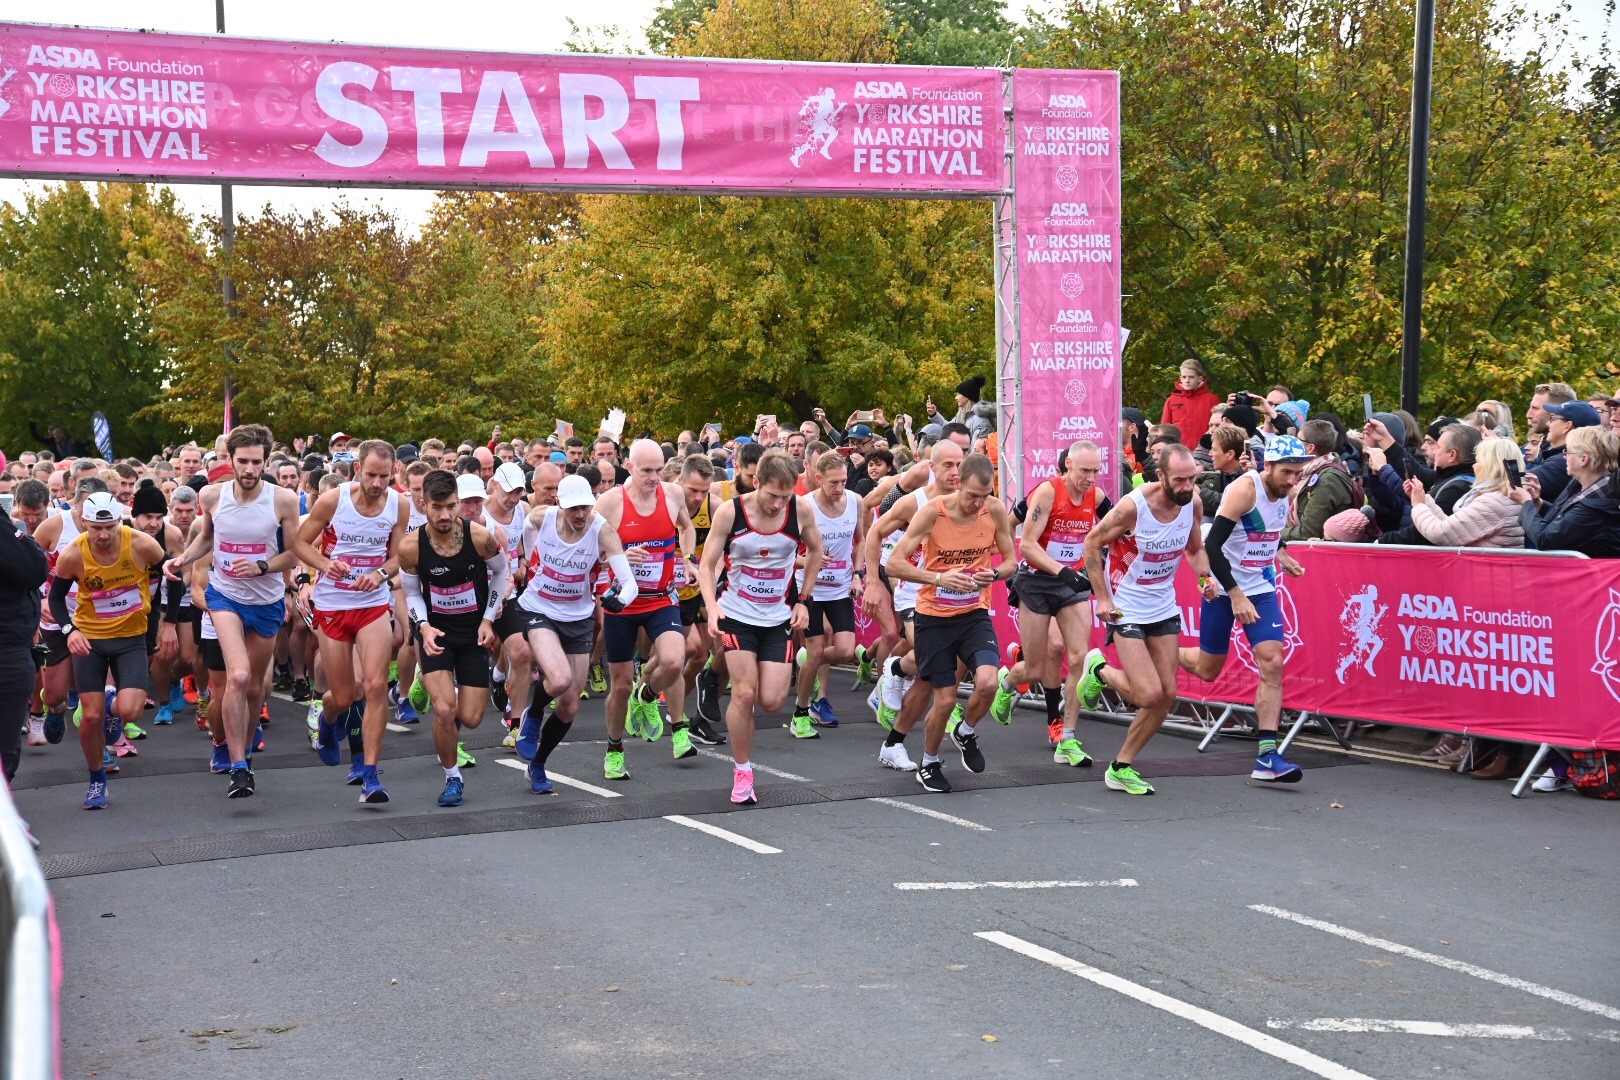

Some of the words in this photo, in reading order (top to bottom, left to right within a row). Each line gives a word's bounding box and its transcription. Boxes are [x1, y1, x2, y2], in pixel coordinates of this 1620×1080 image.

[27, 45, 101, 70] ASDA
[107, 56, 204, 76] Foundation
[853, 81, 907, 99] ASDA
[912, 87, 983, 101] Foundation
[1048, 95, 1086, 108] ASDA
[30, 100, 207, 130] MARATHON
[313, 61, 700, 171] START
[1041, 109, 1093, 119] Foundation
[31, 126, 208, 161] FESTIVAL
[853, 127, 983, 148] MARATHON
[1024, 142, 1110, 156] MARATHON
[853, 149, 983, 176] FESTIVAL
[1050, 203, 1089, 217] ASDA
[1044, 217, 1095, 226] Foundation
[1027, 249, 1112, 263] MARATHON
[1056, 309, 1094, 323] ASDA
[1049, 324, 1098, 333] Foundation
[1029, 356, 1114, 371] MARATHON
[1059, 416, 1097, 430] ASDA
[1052, 430, 1103, 441] Foundation
[1054, 518, 1090, 530] CLOWNE
[341, 533, 386, 545] ENGLAND
[821, 530, 853, 541] NGLAND
[1146, 535, 1186, 550] ENGLAND
[1060, 550, 1074, 558] 176
[543, 553, 588, 570] ENGLAND
[635, 569, 652, 577] 207
[542, 583, 579, 594] MCDOWELL
[746, 584, 775, 594] COOKE
[110, 599, 127, 607] 398
[437, 598, 469, 607] KESTREL
[1397, 593, 1459, 622] ASDA
[1463, 606, 1552, 629] Foundation
[1400, 656, 1555, 698] MARATHON
